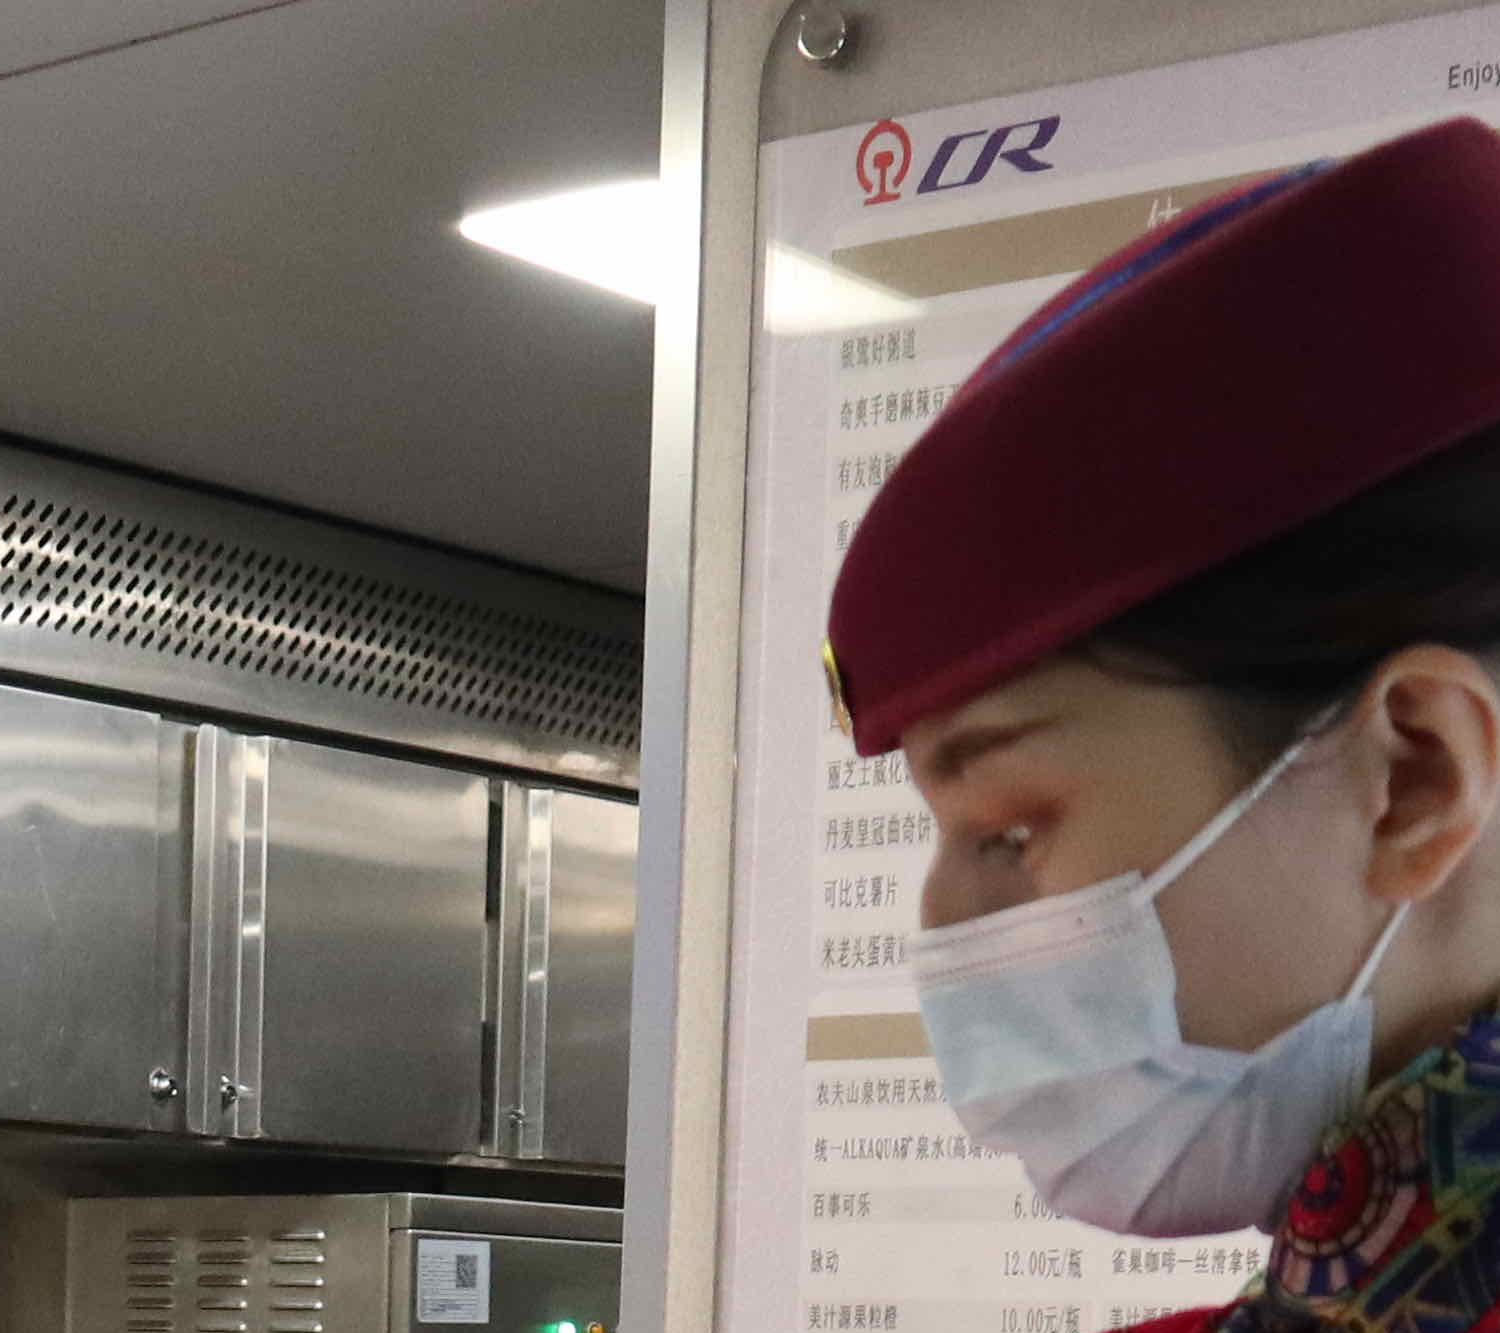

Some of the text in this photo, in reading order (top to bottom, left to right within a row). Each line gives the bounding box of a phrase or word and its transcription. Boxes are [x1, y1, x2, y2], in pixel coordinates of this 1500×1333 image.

[917, 114, 1061, 194] CR
[840, 384, 960, 430] 奇爽手磨麻辣豆
[824, 874, 898, 909] 可比克薯片
[813, 1192, 872, 1218] 百事可乐
[810, 1248, 840, 1274] 脉动
[1003, 1248, 1083, 1279] 12.00元/瓶
[808, 1304, 898, 1331] 美汁源果粒橙
